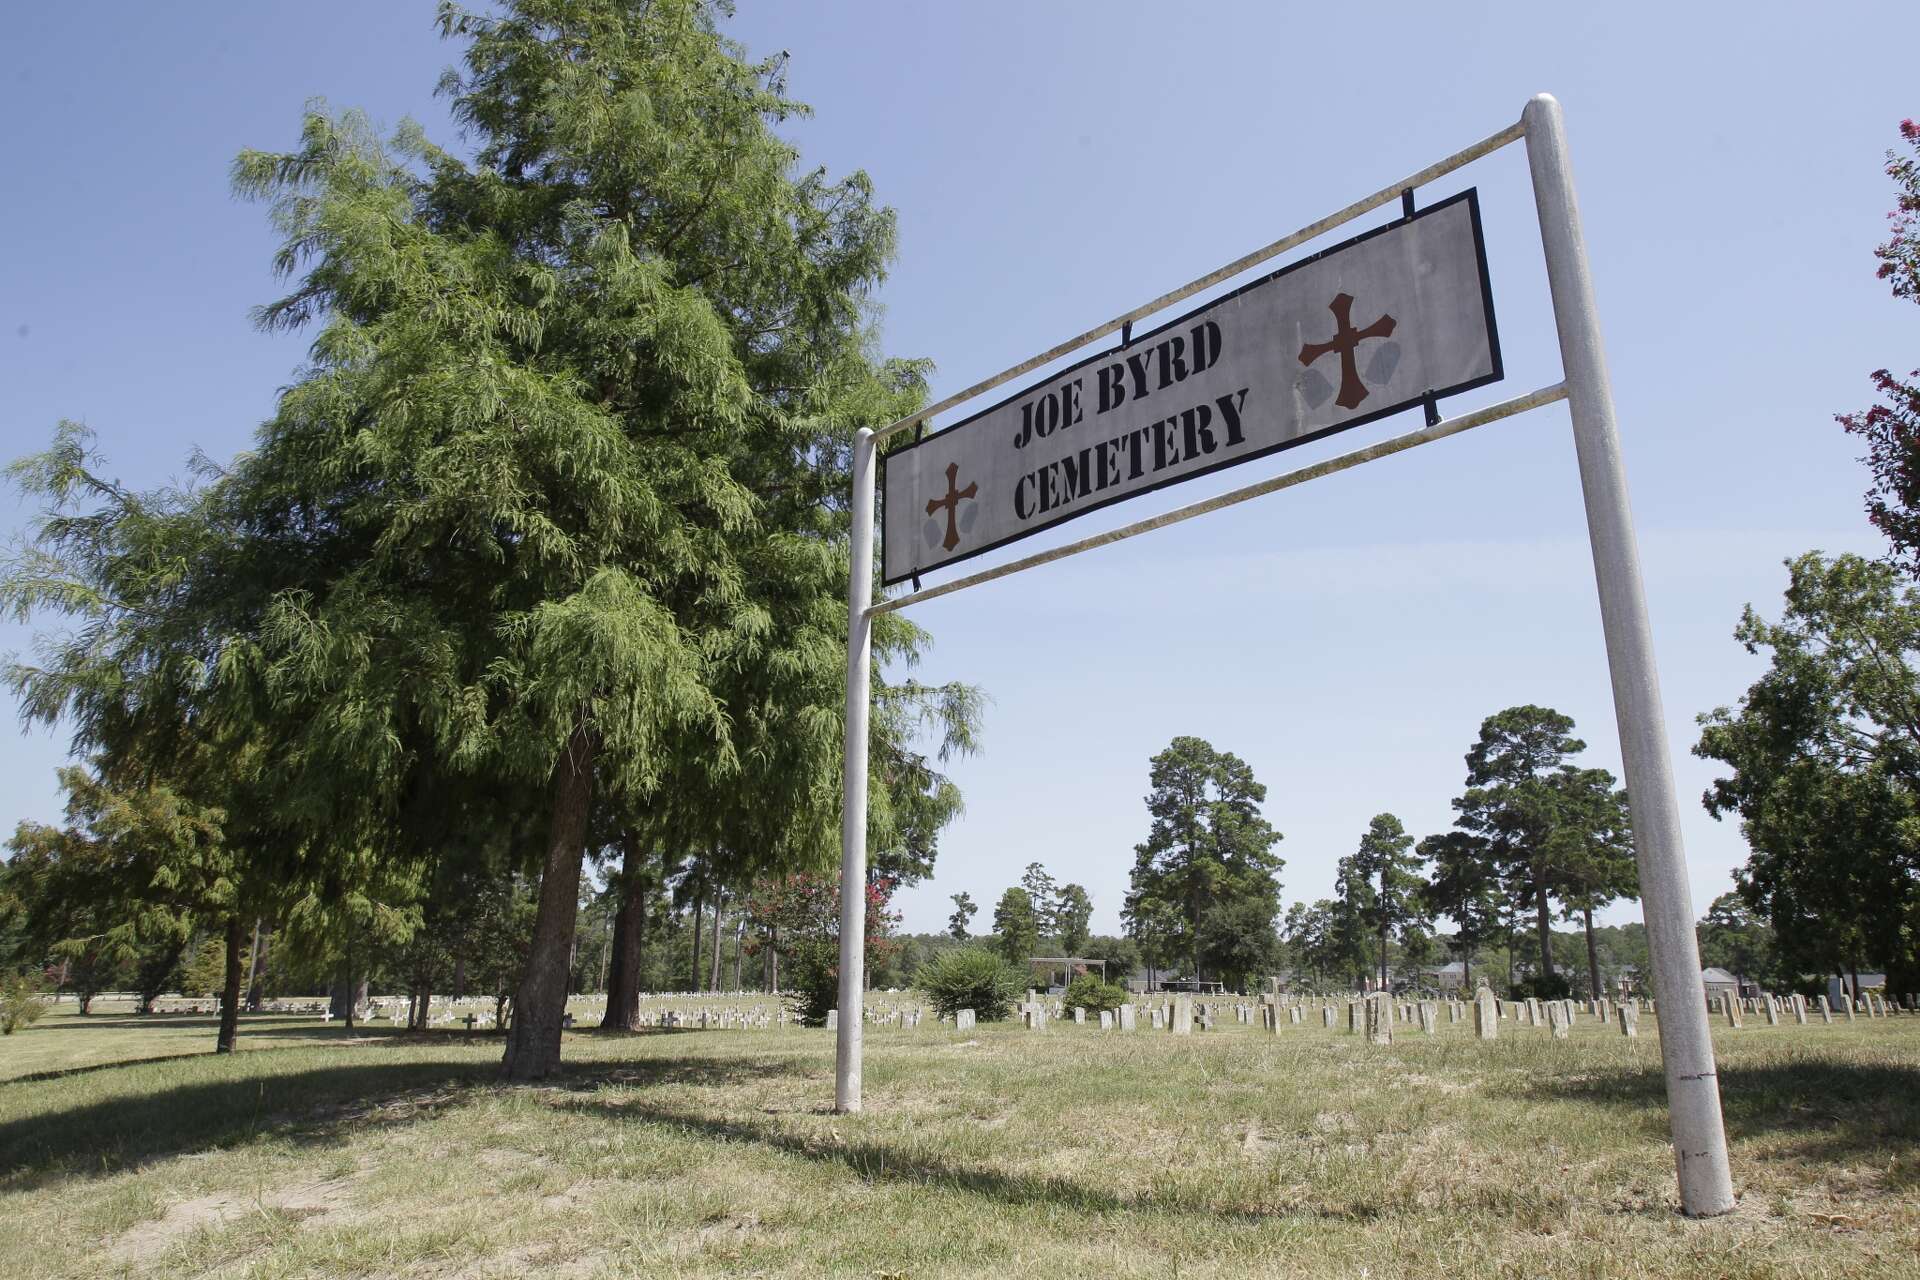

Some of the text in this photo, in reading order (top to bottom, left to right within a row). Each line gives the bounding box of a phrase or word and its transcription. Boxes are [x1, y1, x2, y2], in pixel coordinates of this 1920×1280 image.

[1014, 321, 1222, 449] JOE BYRD
[1014, 387, 1249, 520] CEMETERY
